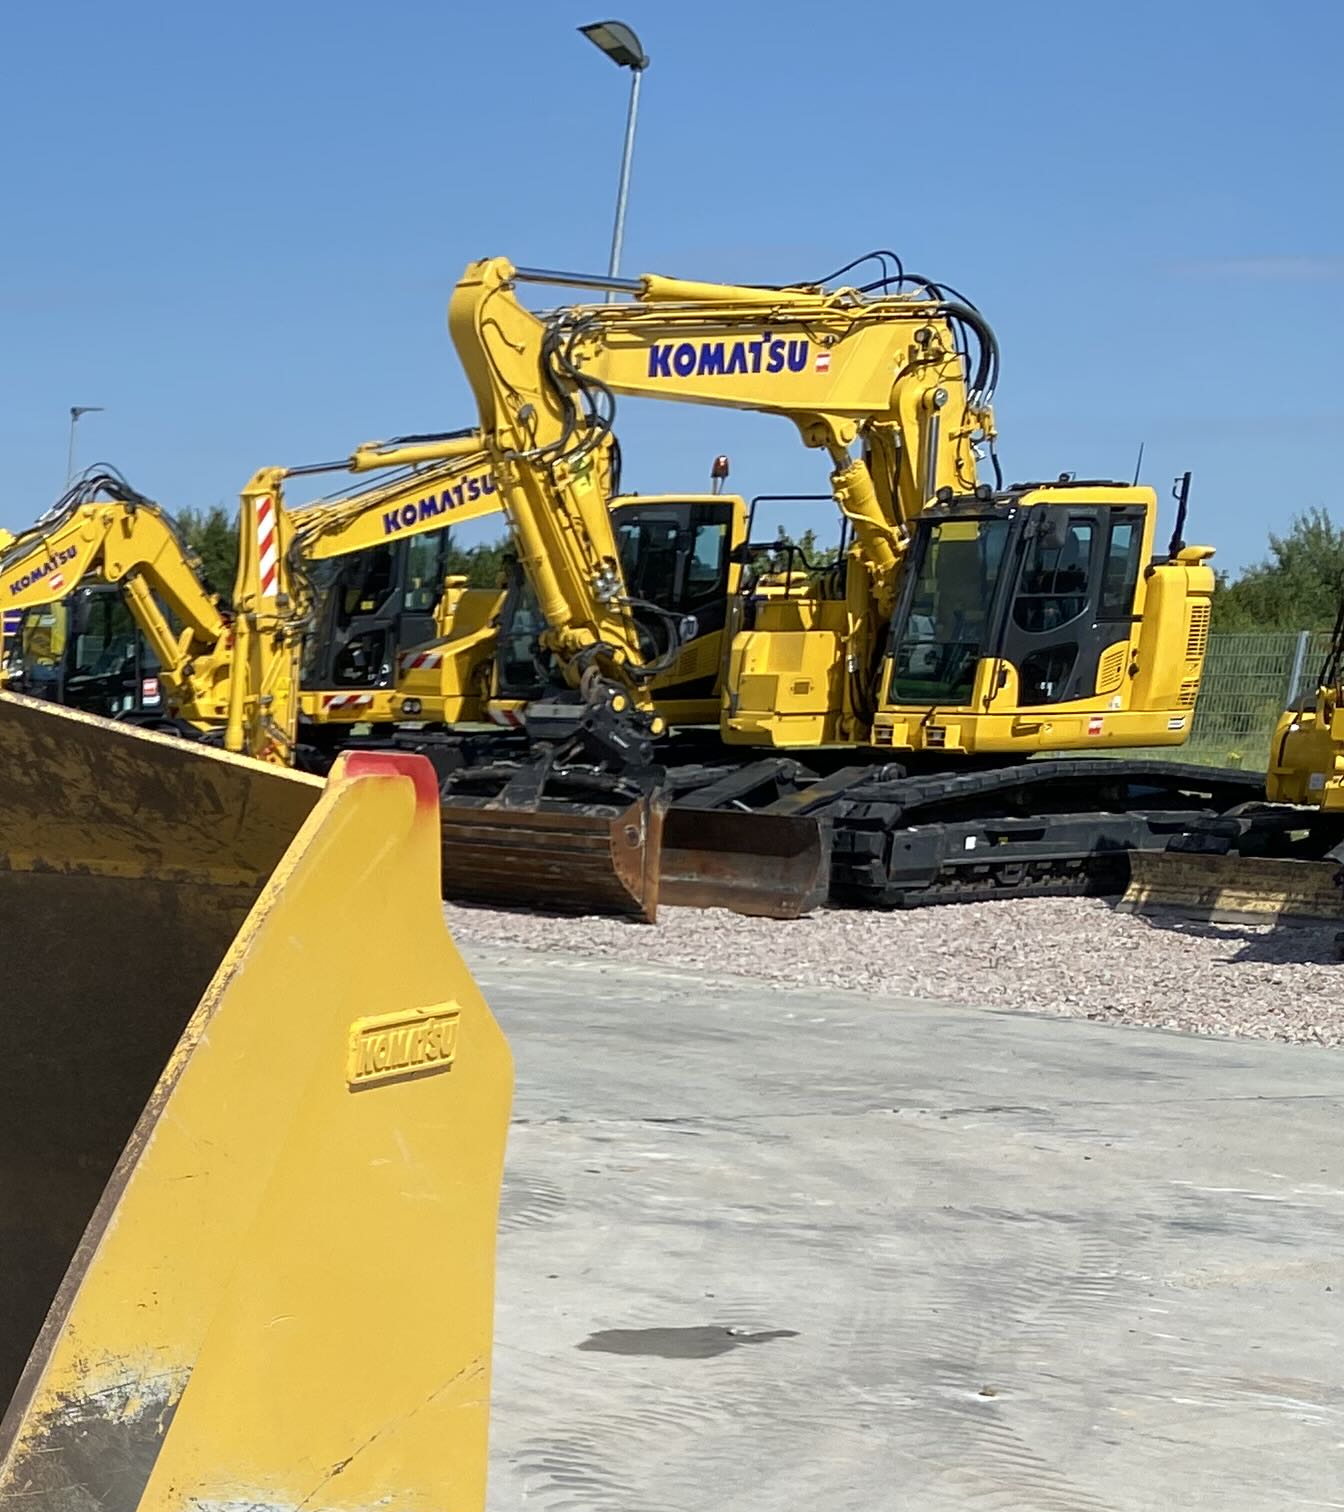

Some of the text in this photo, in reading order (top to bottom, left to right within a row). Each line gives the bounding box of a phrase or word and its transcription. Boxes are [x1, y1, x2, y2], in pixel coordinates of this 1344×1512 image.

[648, 331, 809, 377] KOMATSU
[383, 475, 496, 534] KOMATSU
[10, 545, 77, 593] KOMATSU
[356, 1018, 458, 1078] KOMATSU
